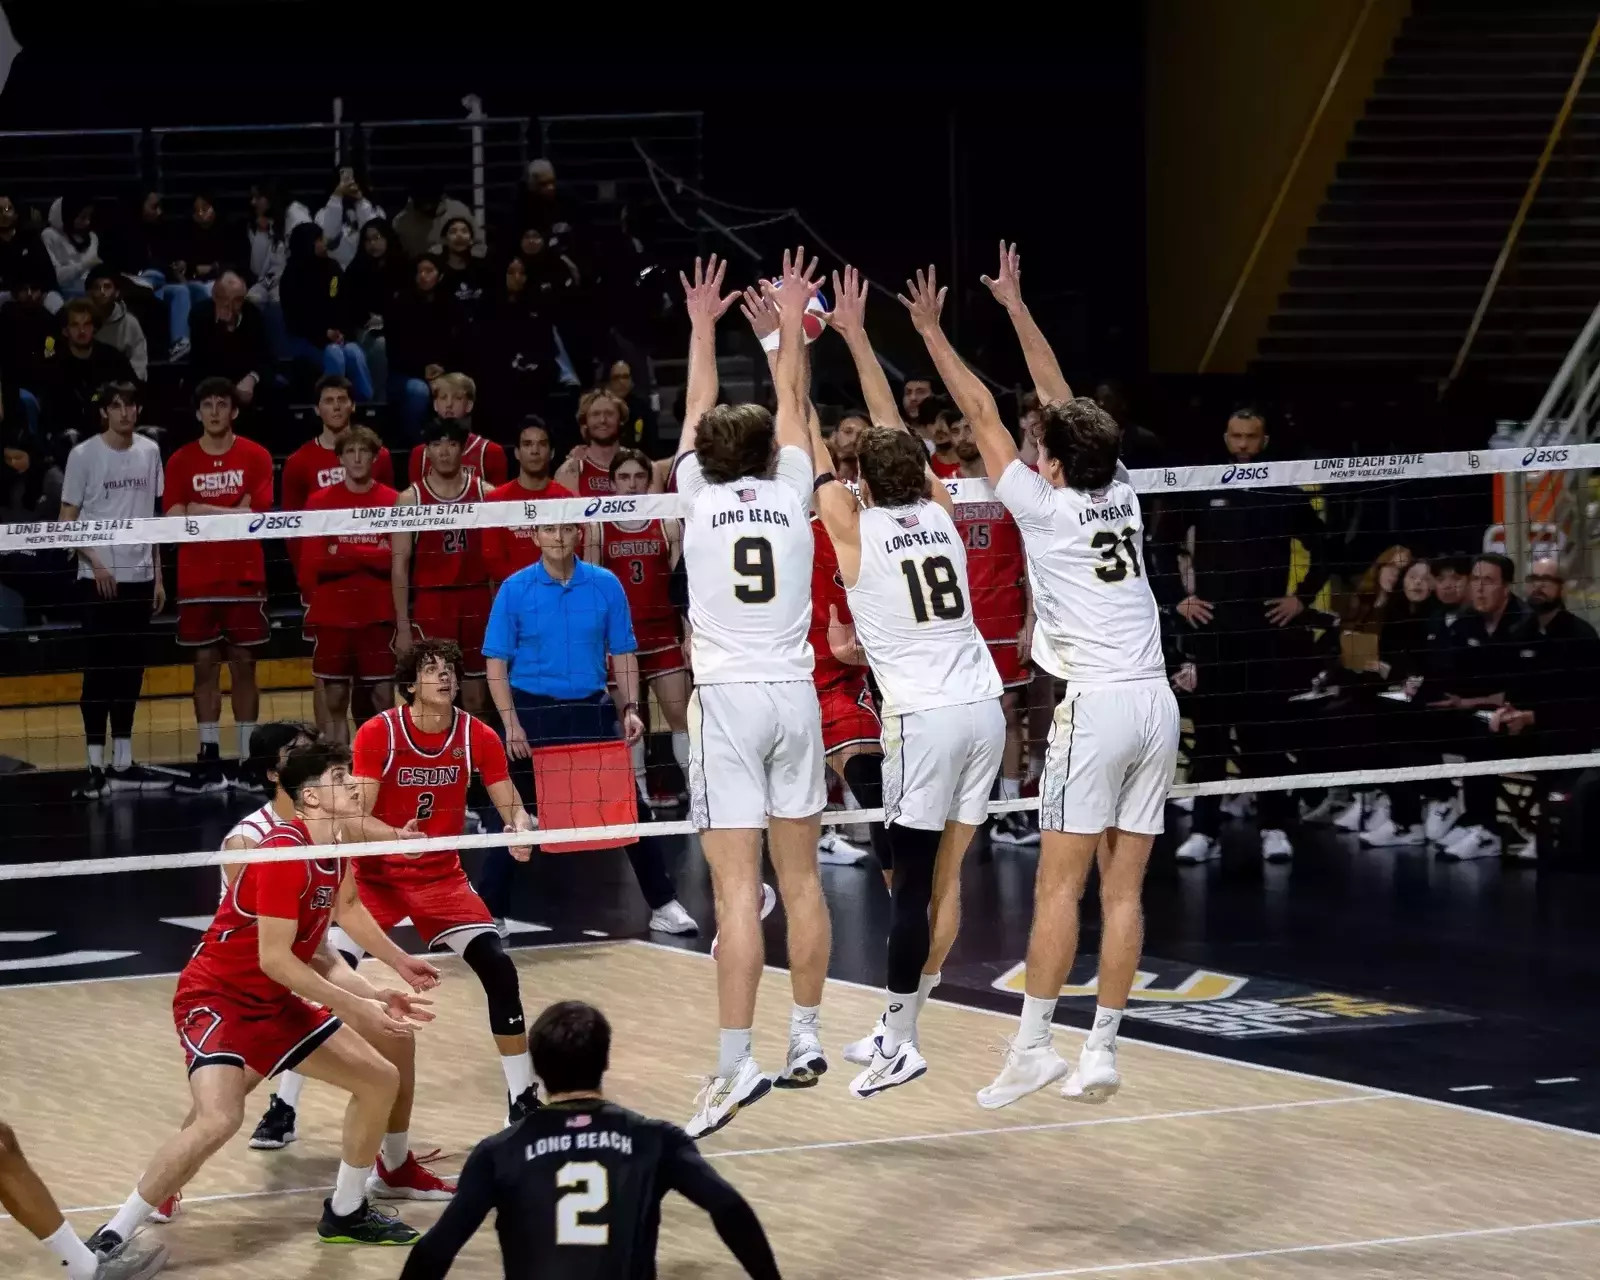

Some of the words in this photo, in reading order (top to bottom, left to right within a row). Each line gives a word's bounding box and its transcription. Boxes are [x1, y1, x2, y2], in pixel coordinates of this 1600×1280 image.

[1314, 459, 1344, 470] LONG
[1348, 456, 1385, 468] BEACH
[1389, 453, 1424, 466] STATE
[1537, 449, 1569, 462] asics
[193, 469, 244, 492] CSUN
[317, 466, 347, 487] CS
[1236, 466, 1269, 480] asics
[1330, 470, 1355, 478] MEN'S
[1357, 467, 1406, 477] VOLLEYBALL
[352, 507, 386, 519] LONG
[390, 505, 431, 517] BEACH
[436, 503, 475, 515] STATE
[602, 500, 636, 514] asics
[1101, 503, 1135, 521] BEACH
[7, 523, 41, 535] LONG
[47, 521, 89, 533] BEACH
[94, 520, 133, 531] STATE
[266, 515, 302, 529] asics
[370, 519, 397, 528] MEN'S
[401, 517, 456, 527] VOLLEYBALL
[712, 509, 744, 528] LONG
[748, 508, 790, 528] BEACH
[25, 535, 55, 544] MEN'S
[59, 533, 115, 543] VOLLEYBALL
[443, 528, 468, 554] 24
[885, 533, 913, 554] LONG
[966, 523, 992, 549] 15
[608, 539, 661, 558] CSUN
[1091, 526, 1141, 583] 31
[629, 560, 645, 585] 3
[734, 536, 776, 604] 9
[900, 554, 966, 624] 18
[398, 765, 460, 787] CSUN
[416, 791, 435, 821] 2
[525, 1134, 572, 1162] LONG
[575, 1130, 633, 1155] BEACH
[555, 1160, 610, 1246] 2
